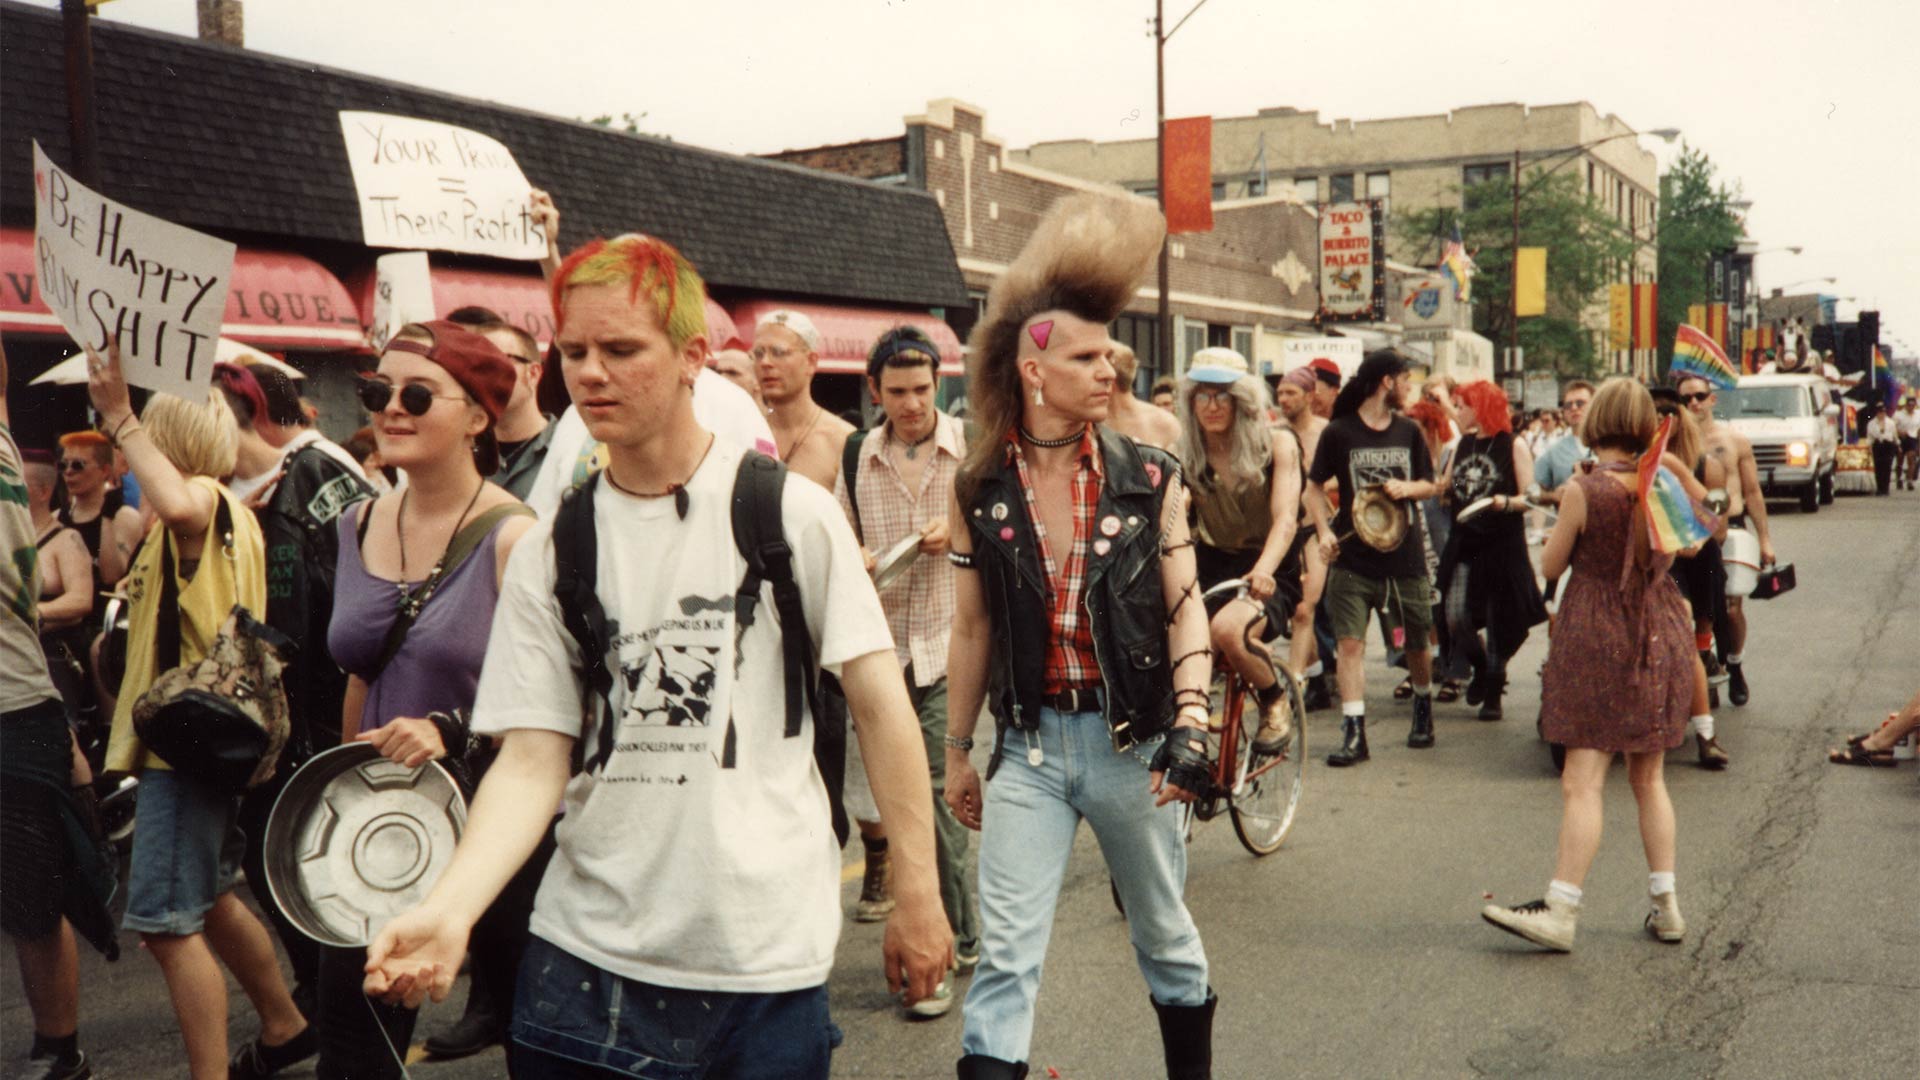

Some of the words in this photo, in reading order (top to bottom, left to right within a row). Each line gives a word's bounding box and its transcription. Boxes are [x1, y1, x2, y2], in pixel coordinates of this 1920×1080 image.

[357, 121, 441, 164] YOUR
[1329, 211, 1364, 225] TACO
[1323, 237, 1369, 251] BURRITO
[1324, 253, 1370, 267] PALACE
[96, 202, 218, 324] HAPPY
[38, 236, 80, 325] BUY
[88, 288, 209, 382] SHIT
[233, 289, 335, 323] IQUE
